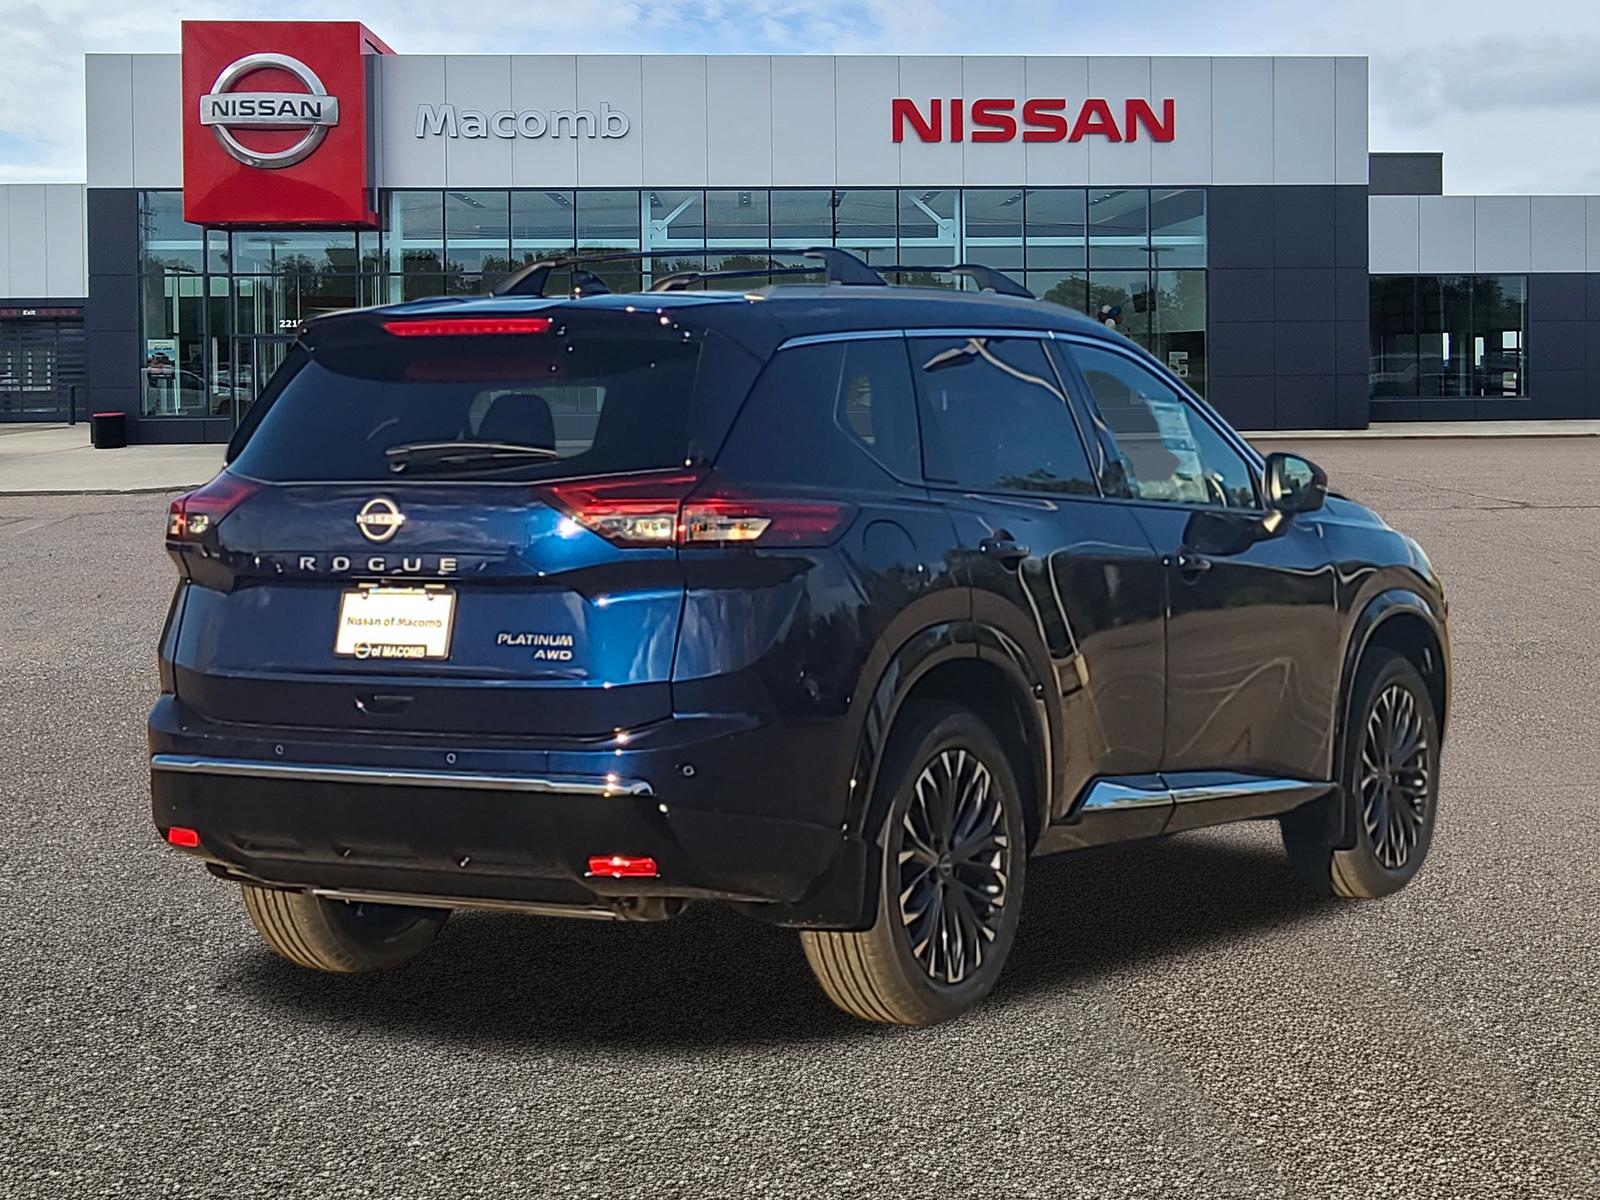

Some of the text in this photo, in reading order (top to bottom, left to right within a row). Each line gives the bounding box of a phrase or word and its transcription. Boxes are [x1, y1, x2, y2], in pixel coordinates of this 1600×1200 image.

[211, 99, 322, 118] NISSAN
[415, 101, 630, 138] Macomb
[892, 98, 1176, 143] NISSAN
[299, 556, 457, 571] ROGUE
[347, 616, 442, 628] Nissan of Macomb
[497, 633, 573, 646] PLATINUM
[371, 646, 425, 657] of MACOMB
[533, 649, 573, 660] AWD
